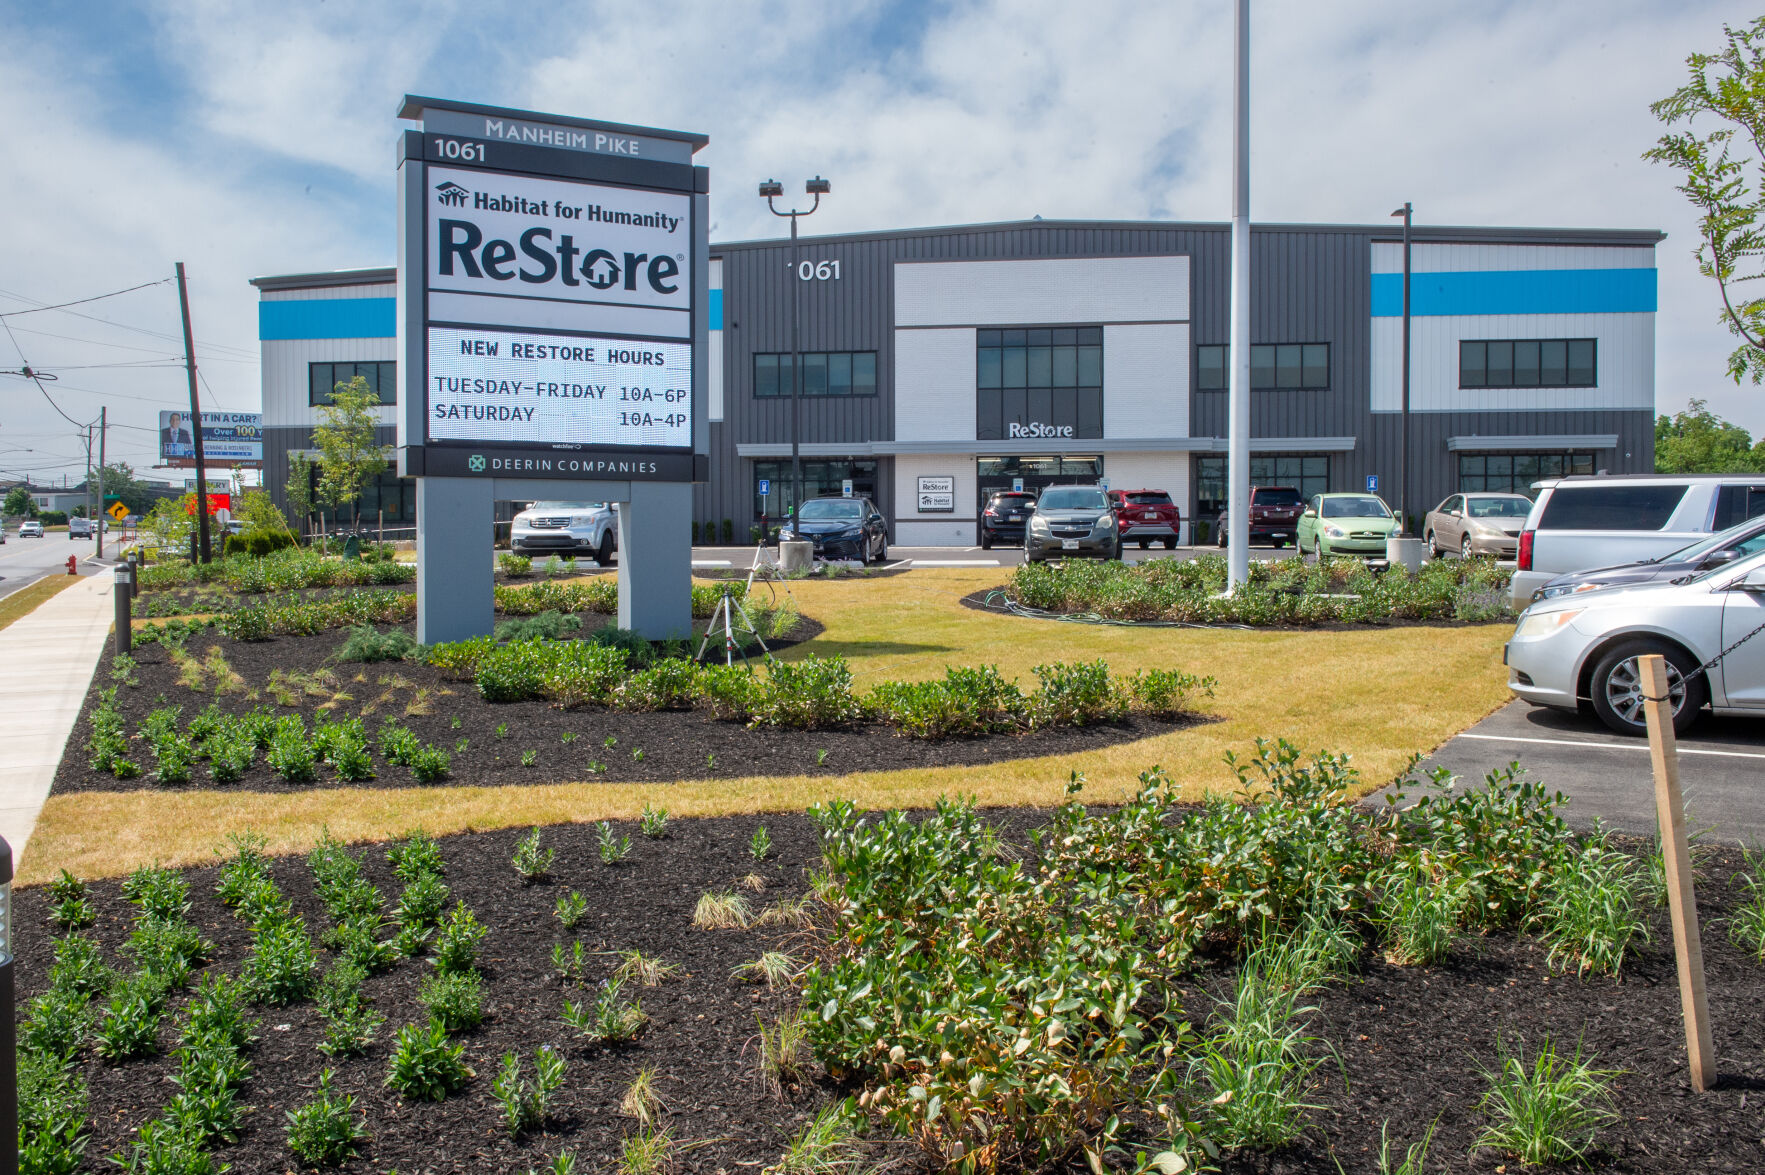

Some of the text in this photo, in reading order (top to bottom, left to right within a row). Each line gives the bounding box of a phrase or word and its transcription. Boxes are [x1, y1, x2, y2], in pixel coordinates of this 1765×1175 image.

[485, 119, 639, 155] MANHEIM PIKE
[434, 139, 486, 162] 1061
[474, 192, 679, 233] Habitat for Humanity
[787, 260, 840, 281] 061
[461, 339, 665, 366] NEW RESTORE HOURS
[434, 376, 687, 403] TUESDAY-FRIDAY 10A-6P
[211, 414, 220, 422] IN
[223, 414, 230, 423] A
[231, 414, 257, 423] CAR?
[435, 404, 687, 428] SATURDAY 10A-4P
[235, 425, 255, 437] 100
[1009, 421, 1073, 438] ReStore
[492, 457, 657, 473] DEERIN COMPANIES
